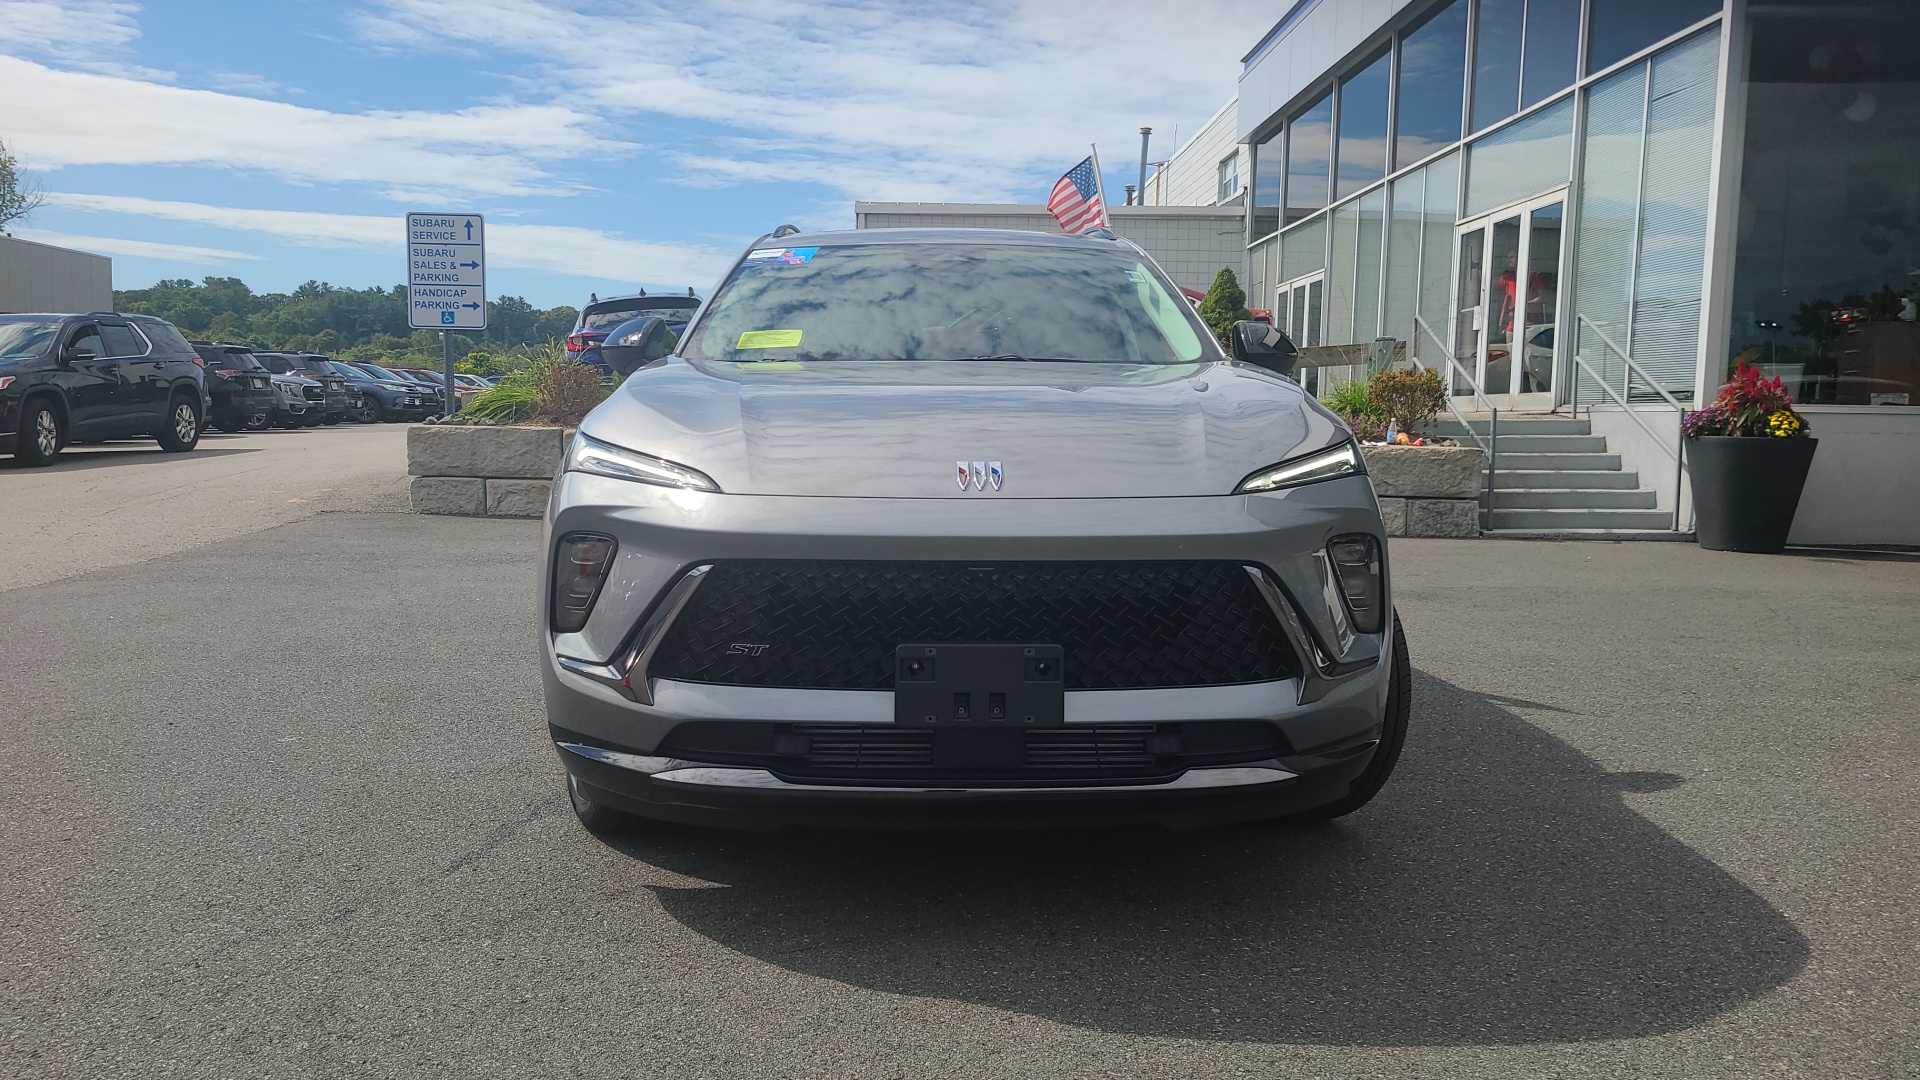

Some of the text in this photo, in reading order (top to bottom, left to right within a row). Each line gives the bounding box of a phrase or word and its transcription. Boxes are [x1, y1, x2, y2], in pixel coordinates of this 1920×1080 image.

[412, 219, 455, 228] SUBARU
[412, 231, 456, 240] SERVICE
[413, 249, 456, 257] SUBARU
[413, 261, 457, 270] SALES &
[414, 273, 459, 282] PARKING
[414, 289, 467, 297] HANDICAP
[414, 301, 460, 310] PARKING
[726, 643, 770, 656] ST
